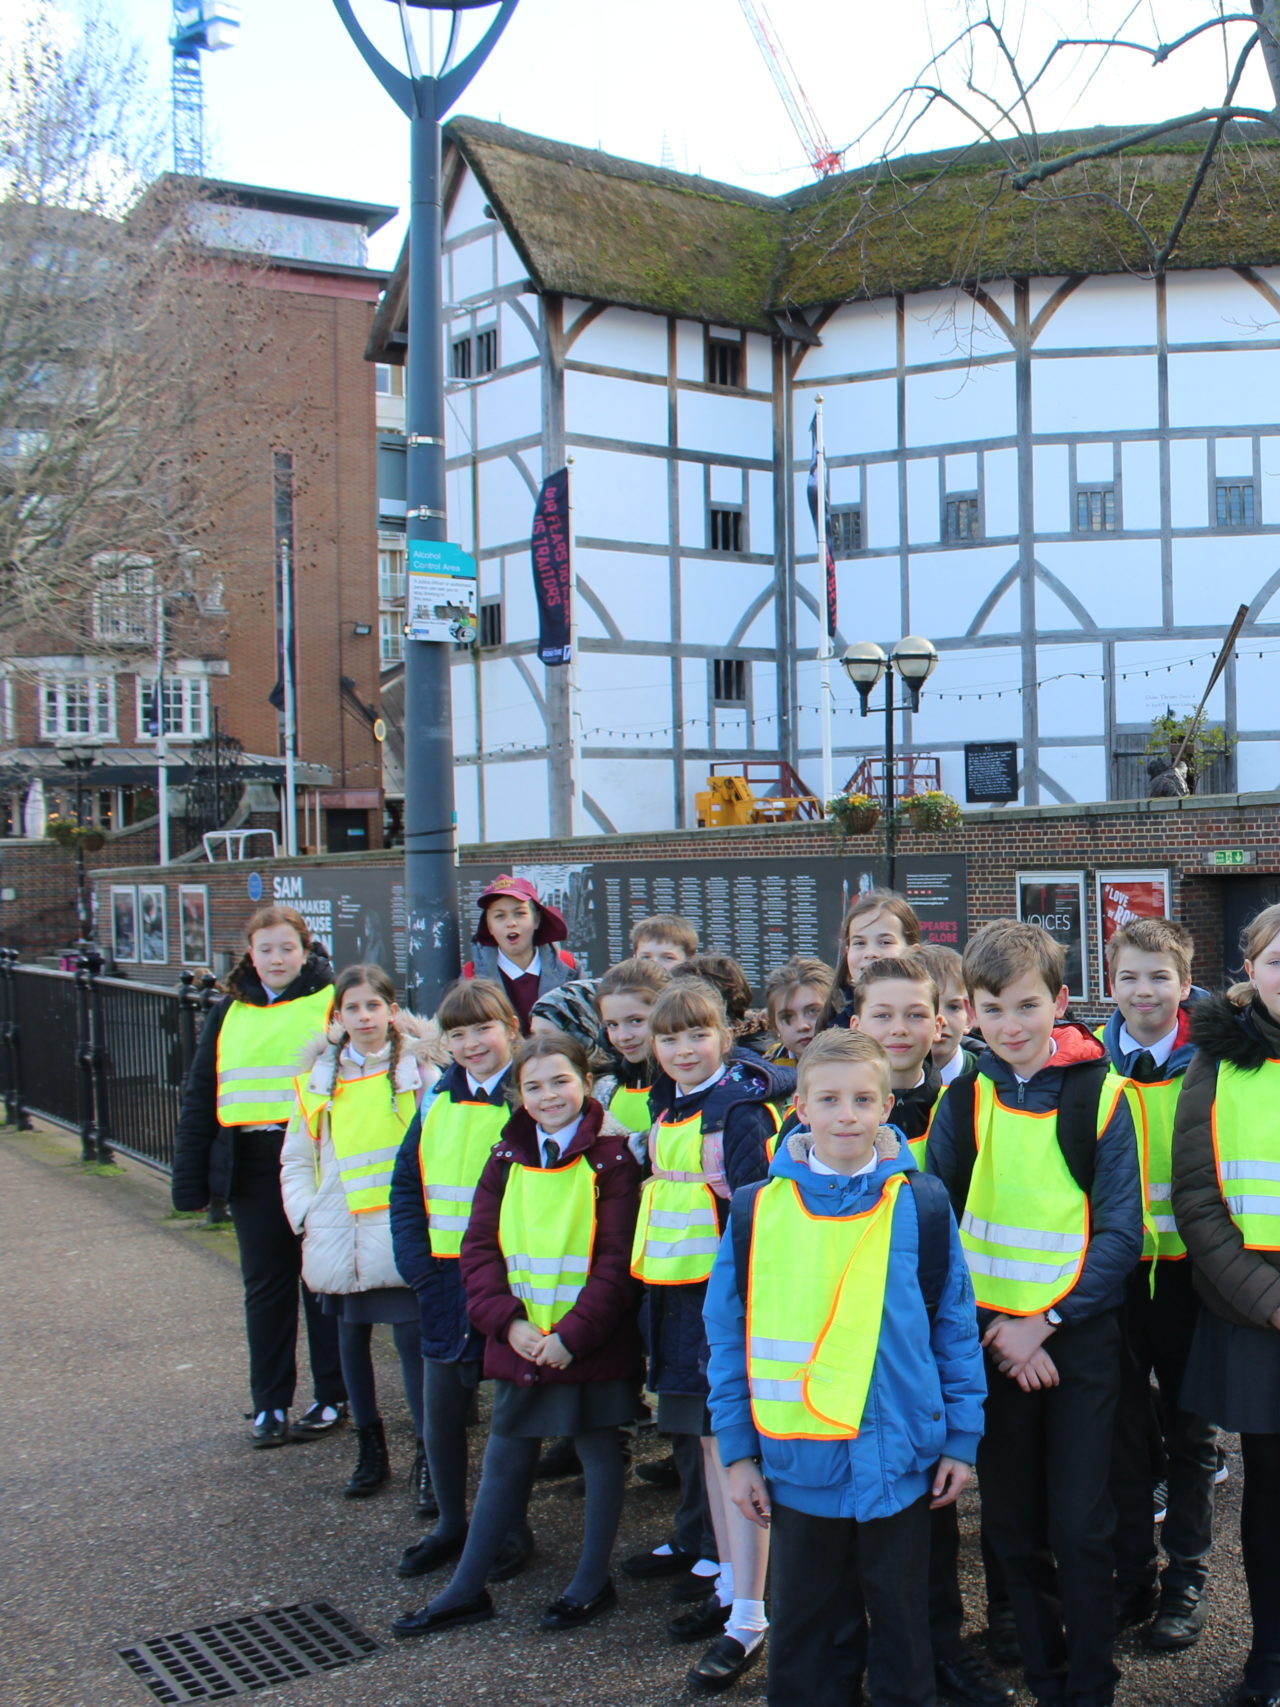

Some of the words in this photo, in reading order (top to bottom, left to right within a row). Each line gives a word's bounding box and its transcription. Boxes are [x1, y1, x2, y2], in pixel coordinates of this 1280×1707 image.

[412, 550, 441, 560] Alcohol
[412, 560, 441, 570] Control
[442, 562, 461, 572] Area
[272, 876, 303, 899] SAM
[1108, 887, 1130, 908] LOVE
[1022, 914, 1071, 931] VOICES
